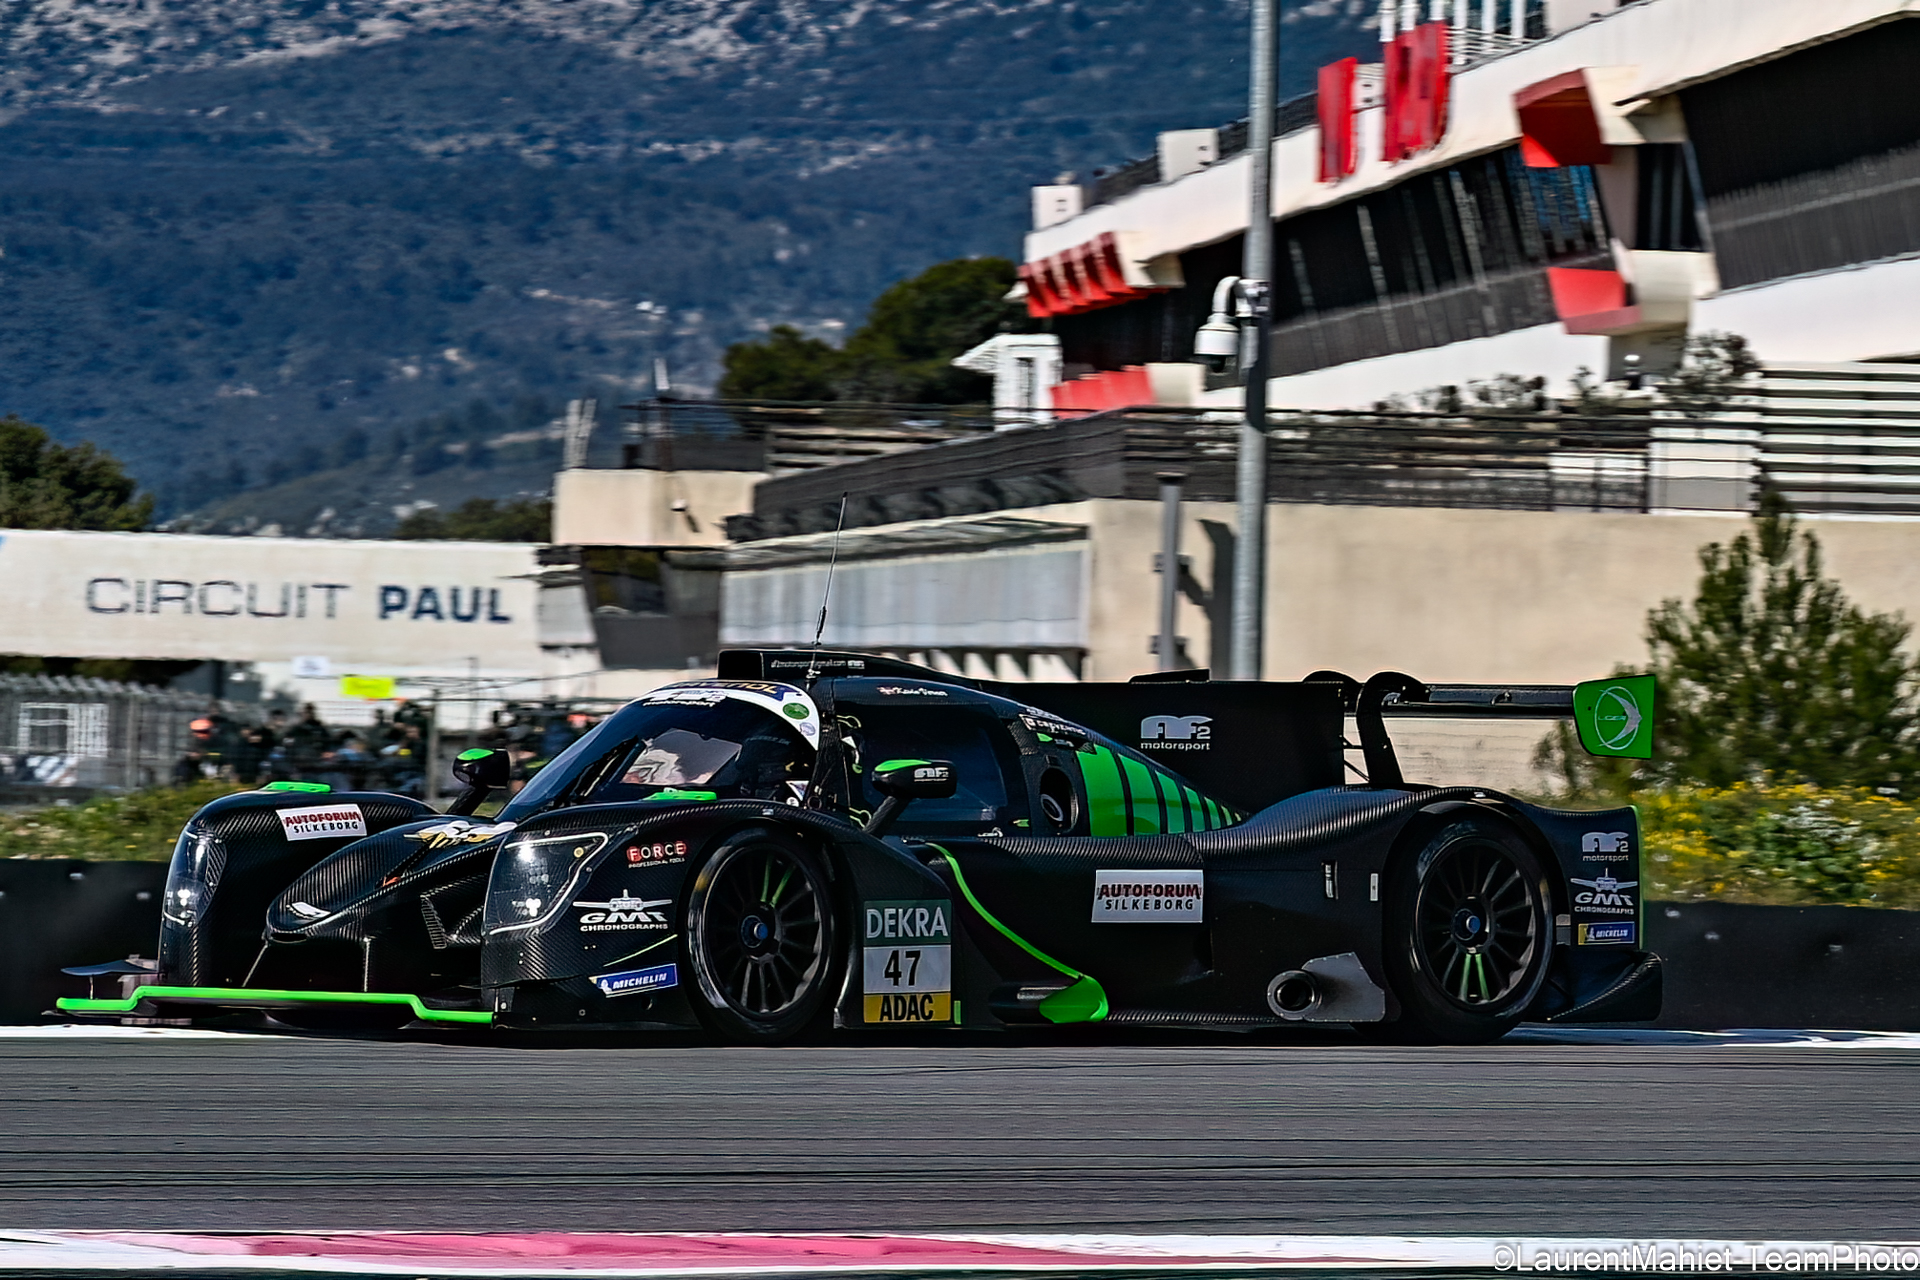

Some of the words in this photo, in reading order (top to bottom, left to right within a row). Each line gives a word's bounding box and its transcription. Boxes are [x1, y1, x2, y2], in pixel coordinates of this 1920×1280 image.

[86, 577, 349, 619] CIRCUIT
[378, 584, 513, 623] PAUL
[1140, 742, 1211, 751] motorsport
[284, 811, 362, 828] AUTOFORUM
[293, 821, 359, 834] SILKEBORG
[627, 841, 687, 862] FORCE
[1582, 854, 1629, 862] motorsport
[1097, 884, 1202, 900] AUTOFORUM
[1574, 892, 1634, 906] GMT
[1105, 899, 1193, 910] SILKEBORG
[1574, 906, 1634, 915] CHRONOGRAPHS
[580, 911, 668, 924] GMT
[866, 906, 949, 939] DEKRA
[580, 923, 668, 932] CHRONOGRAPHS
[1595, 928, 1629, 938] MICHELIN
[884, 949, 921, 987] 47
[612, 973, 667, 990] MICHELIN
[880, 994, 934, 1021] ADAC
